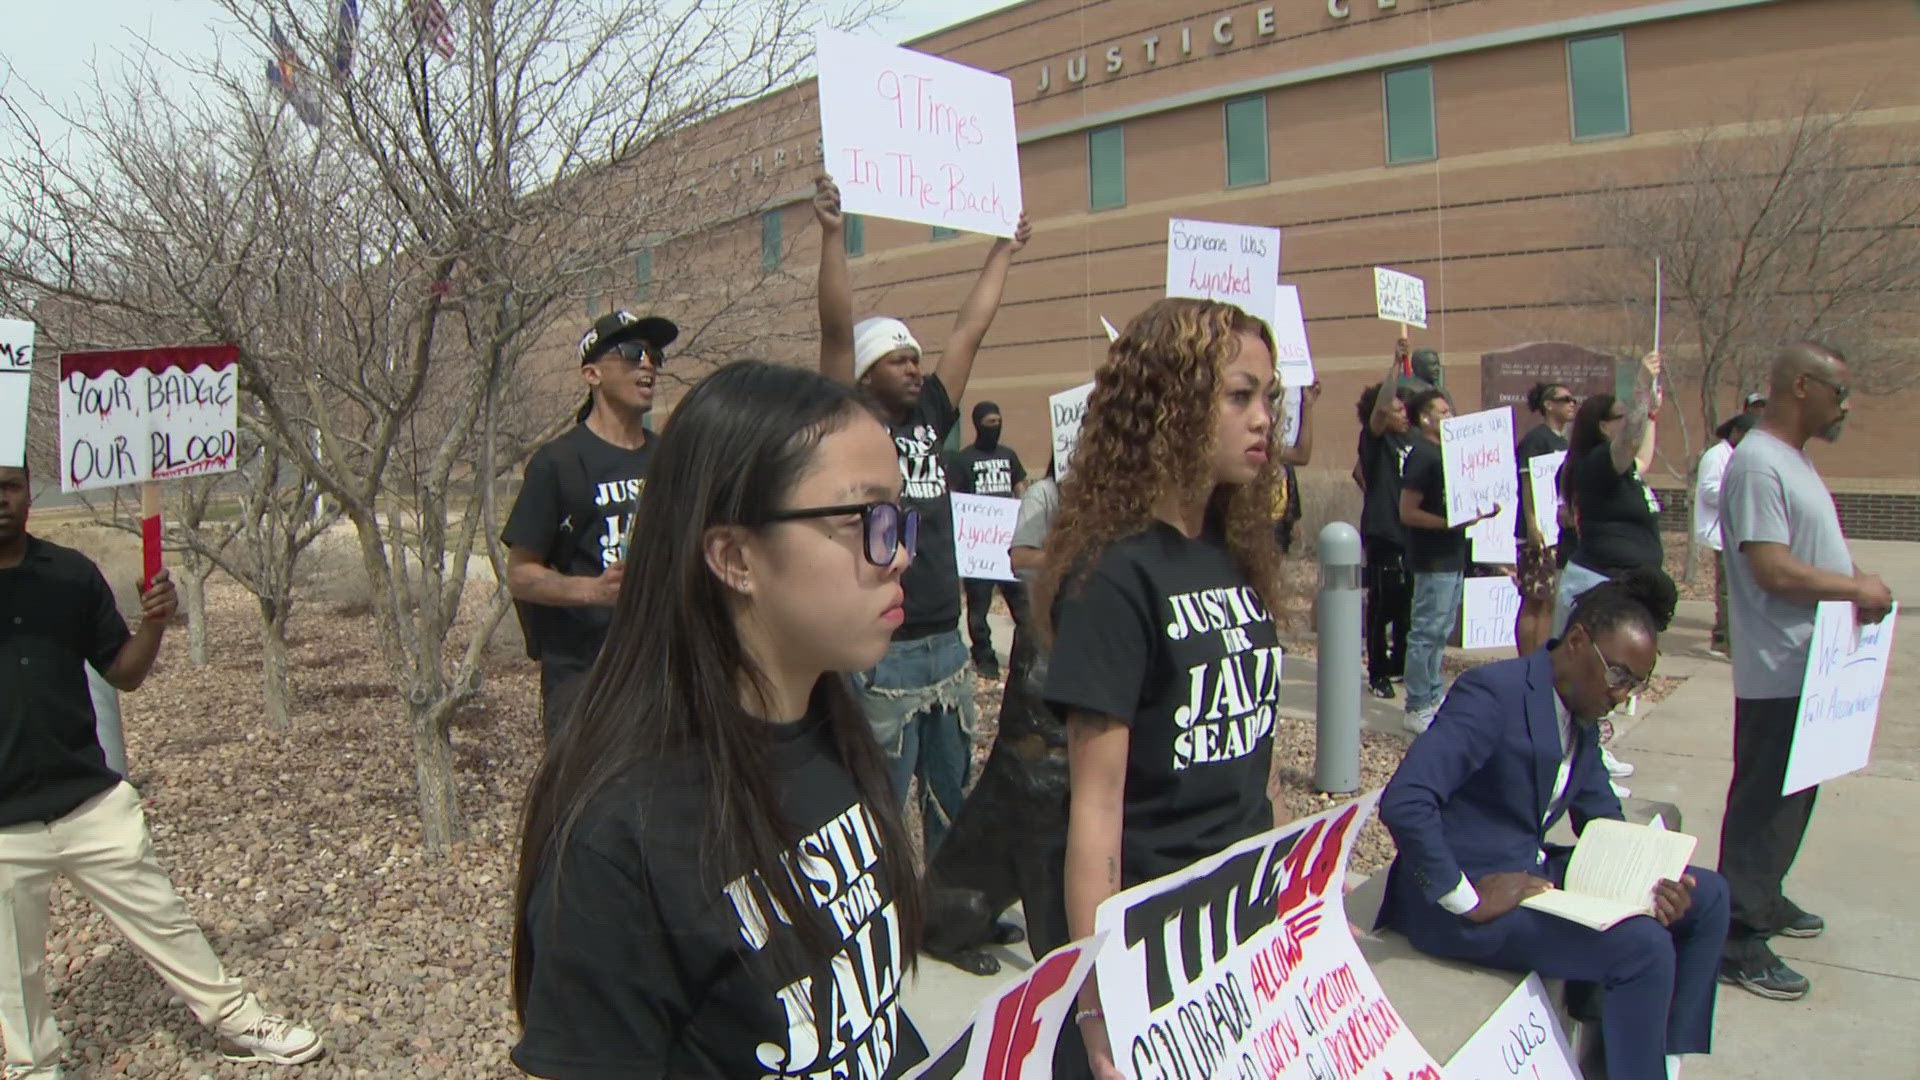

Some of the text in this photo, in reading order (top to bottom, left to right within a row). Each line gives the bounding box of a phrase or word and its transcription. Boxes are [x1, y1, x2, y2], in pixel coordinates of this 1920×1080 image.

[1037, 6, 1276, 94] JUSTICE
[878, 69, 984, 151] 9 Times
[843, 147, 1012, 226] In The Back
[1189, 257, 1251, 299] Lynched
[68, 373, 234, 415] YOUR BADGE
[71, 430, 235, 484] OUR BLOOD
[1166, 586, 1274, 641] JUSTIC
[828, 872, 882, 941] FOR
[1124, 829, 1306, 1013] TITLE
